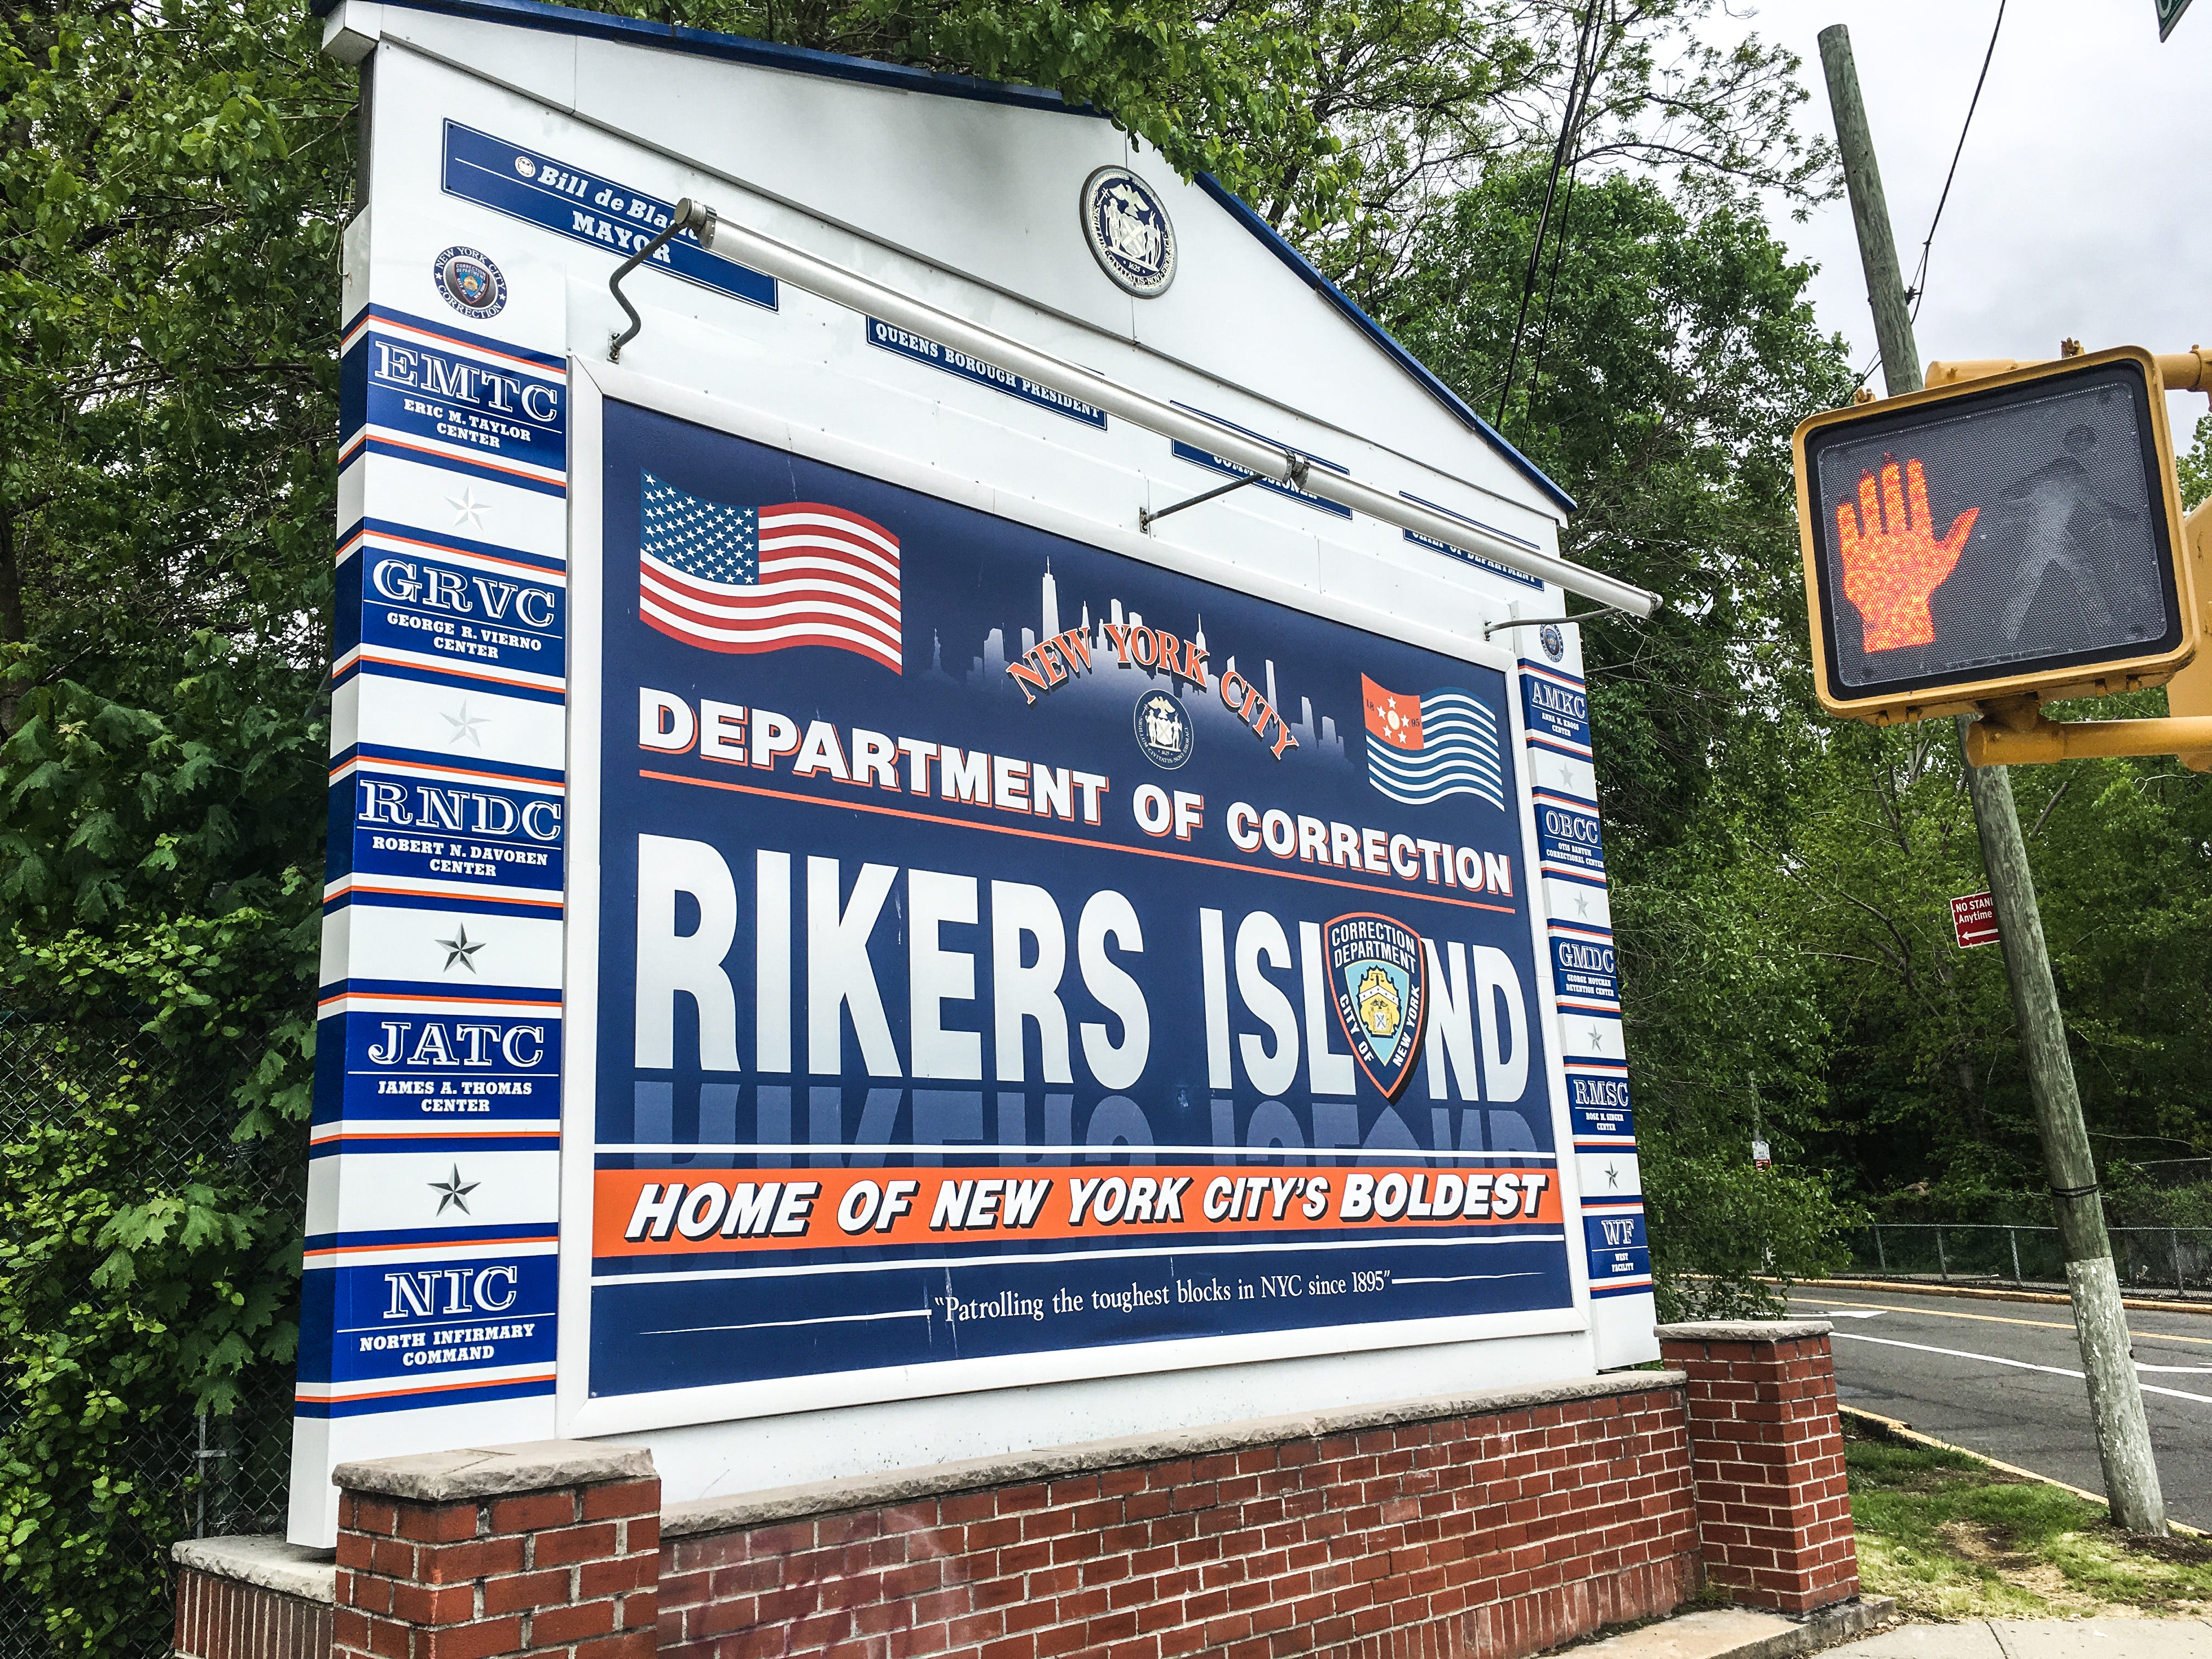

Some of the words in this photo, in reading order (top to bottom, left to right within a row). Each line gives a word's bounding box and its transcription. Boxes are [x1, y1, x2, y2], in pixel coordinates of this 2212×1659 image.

[537, 166, 589, 198] Bill
[594, 188, 624, 211] de
[627, 199, 698, 240] Bla
[572, 211, 671, 263] MAYOR
[436, 249, 454, 269] NEW
[456, 247, 488, 264] YORK
[489, 264, 506, 290] CITY
[1128, 262, 1141, 272] 1625
[438, 285, 502, 318] CORRECTION
[375, 341, 557, 422] EMTC
[876, 323, 938, 358] QUEENS
[944, 348, 1017, 388] BOROUGH
[1022, 379, 1099, 418] PRESIDENT
[404, 398, 443, 419] ERIC
[448, 409, 466, 424] M.
[469, 417, 531, 442] TAYLOR
[437, 423, 500, 448] CENTER
[373, 559, 555, 627] GRVC
[387, 612, 454, 634] GEORGE
[461, 626, 477, 640] R.
[481, 629, 542, 651] VIERNO
[433, 637, 499, 659] CENTER
[1006, 627, 1091, 706] NEW
[1103, 623, 1210, 689] YORK
[1220, 670, 1300, 760] CITY
[1365, 699, 1374, 711] 18
[1532, 681, 1585, 719] AMKC
[1411, 718, 1420, 727] 95
[1552, 724, 1571, 737] CENTER
[1148, 748, 1172, 763] CIVITATIS
[639, 686, 1109, 826] DEPARTMENT
[1132, 783, 1204, 841] OF
[1227, 801, 1513, 897] CORRECTION
[358, 780, 561, 841] RNDC
[1545, 810, 1598, 844] OBCC
[373, 836, 445, 855] ROBERT
[450, 845, 466, 857] N.
[470, 847, 548, 866] DAVOREN
[1546, 849, 1584, 864] CORRECTIONAL
[1585, 857, 1604, 868] CENTER
[1558, 842, 1570, 851] OTIS
[430, 859, 496, 877] CENTER
[1955, 902, 1968, 913] NO
[1969, 897, 1993, 910] STAN
[1959, 911, 1993, 924] Anytime
[1331, 921, 1415, 955] CORRECTION
[635, 833, 1150, 1090] RIKERS
[1200, 907, 1528, 1102] ISLND
[1334, 940, 1416, 974] DEPARTMENT
[1559, 942, 1614, 973] GMDC
[1566, 983, 1594, 994] DETENTION
[1595, 988, 1615, 997] CENTER
[1567, 974, 1587, 983] GEORGE
[1340, 994, 1360, 1034] CITY
[1358, 1040, 1374, 1063] OF
[1392, 1031, 1412, 1067] NEW
[1406, 984, 1420, 1028] YORK
[368, 1022, 544, 1068] JATC
[377, 1081, 435, 1094] JAMES
[440, 1081, 458, 1094] A.
[461, 1082, 532, 1095] THOMAS
[1573, 1079, 1628, 1107] RMSC
[421, 1099, 490, 1112] CENTER
[1596, 1122, 1616, 1131] CENTER
[624, 1182, 822, 1243] HOME
[837, 1180, 918, 1236] OF
[929, 1179, 1053, 1231] NEW
[1068, 1176, 1195, 1226] YORK
[1204, 1175, 1330, 1223] CITY'S
[1339, 1173, 1549, 1223] BOLDEST
[1601, 1218, 1634, 1245] WF
[1615, 1252, 1628, 1261] WEST
[383, 1266, 517, 1319] NIC
[934, 1290, 1043, 1322] "Patrolling
[1052, 1287, 1084, 1314] the
[1091, 1282, 1170, 1312] toughest
[1177, 1278, 1231, 1304] blocks
[1238, 1279, 1255, 1300] in
[1261, 1274, 1303, 1298] NYC
[1308, 1275, 1347, 1296] since
[1351, 1269, 1391, 1293] 1895"
[359, 1333, 426, 1352] NORTH
[433, 1323, 535, 1346] INFIRMARY
[402, 1345, 494, 1367] COMMAND
